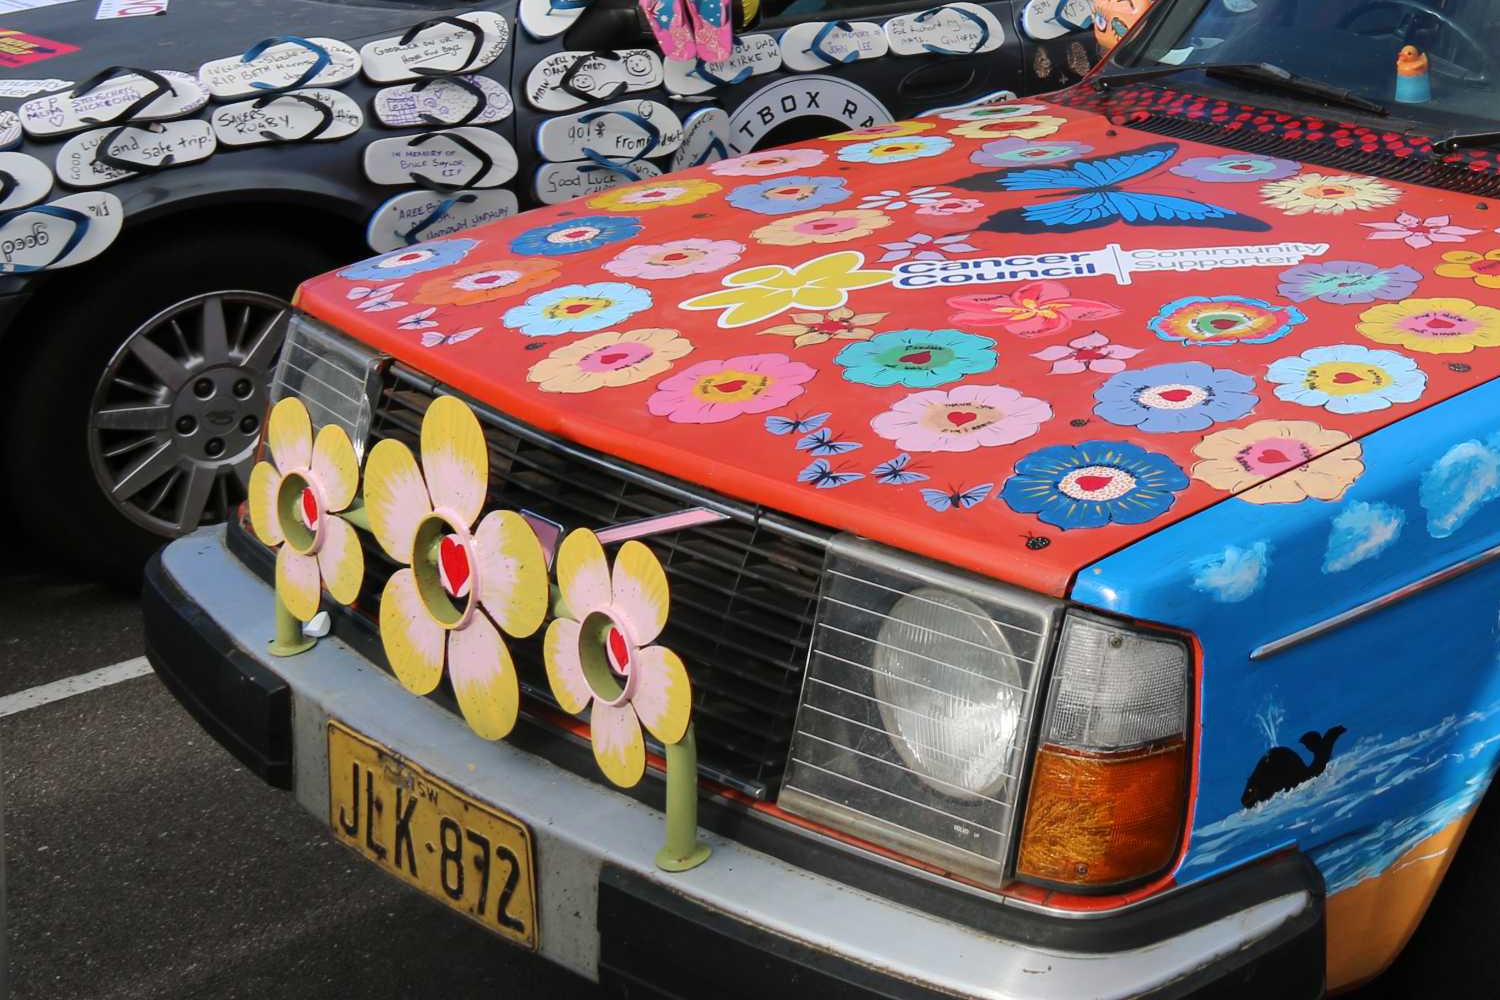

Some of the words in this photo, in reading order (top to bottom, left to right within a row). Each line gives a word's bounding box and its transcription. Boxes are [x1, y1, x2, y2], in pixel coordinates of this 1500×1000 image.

[26, 107, 64, 121] MUM
[1130, 242, 1326, 260] Community
[899, 251, 1092, 275] Cancer
[1134, 254, 1300, 271] Supporter
[899, 262, 1097, 288] Council
